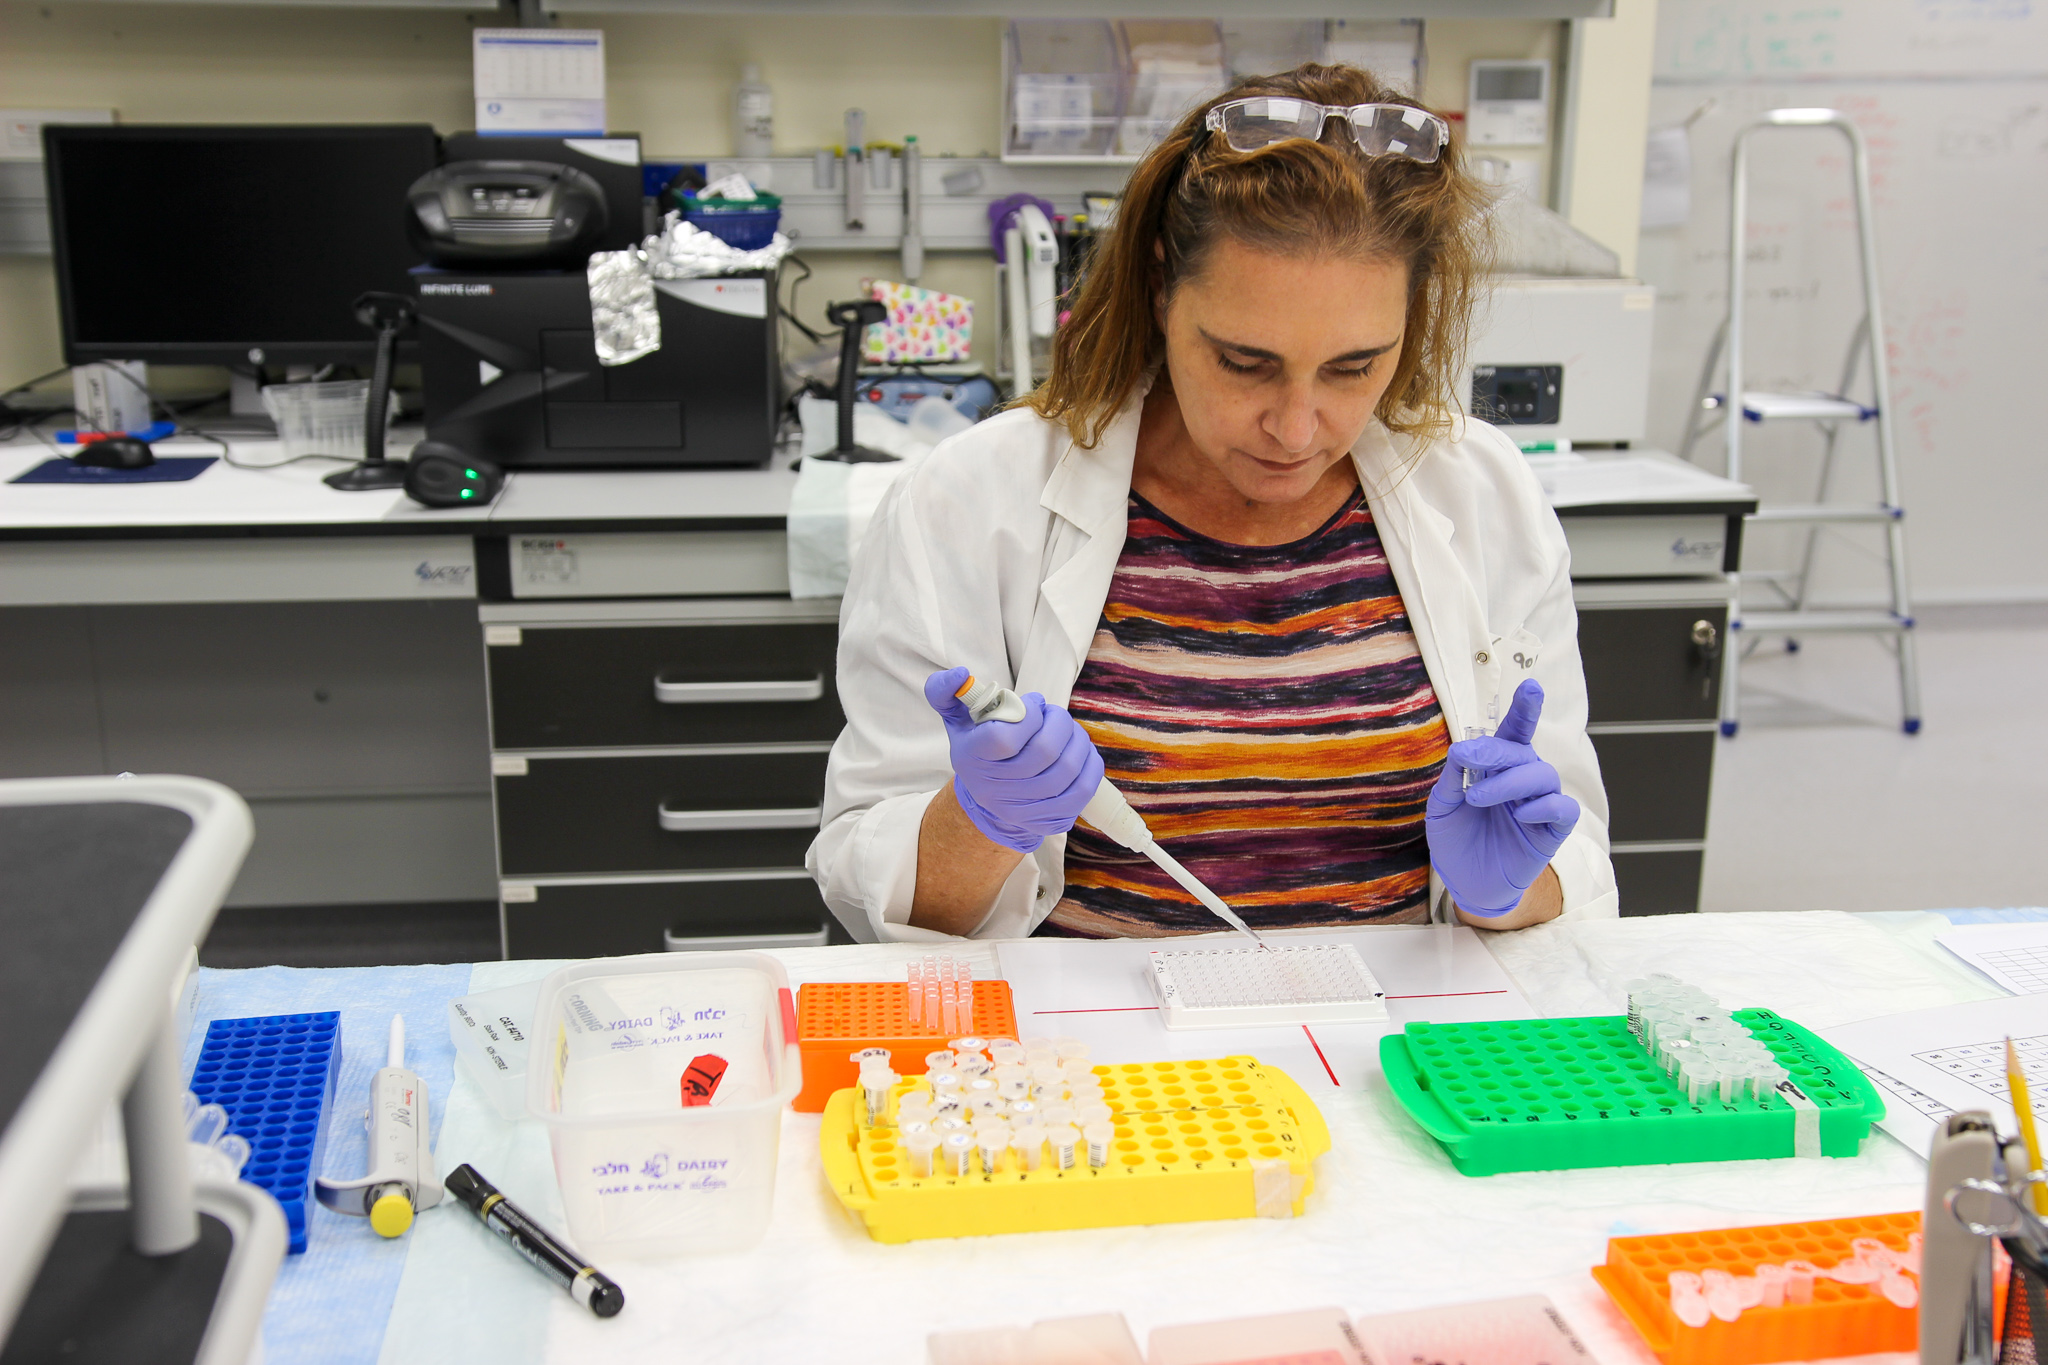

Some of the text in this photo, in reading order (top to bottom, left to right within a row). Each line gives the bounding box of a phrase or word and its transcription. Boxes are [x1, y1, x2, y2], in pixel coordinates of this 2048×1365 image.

[420, 283, 464, 296] INFINITE
[568, 994, 604, 1033] CORNING
[678, 1159, 728, 1171] DAIRY
[598, 1185, 629, 1195] TAKE
[648, 1183, 682, 1191] PACK
